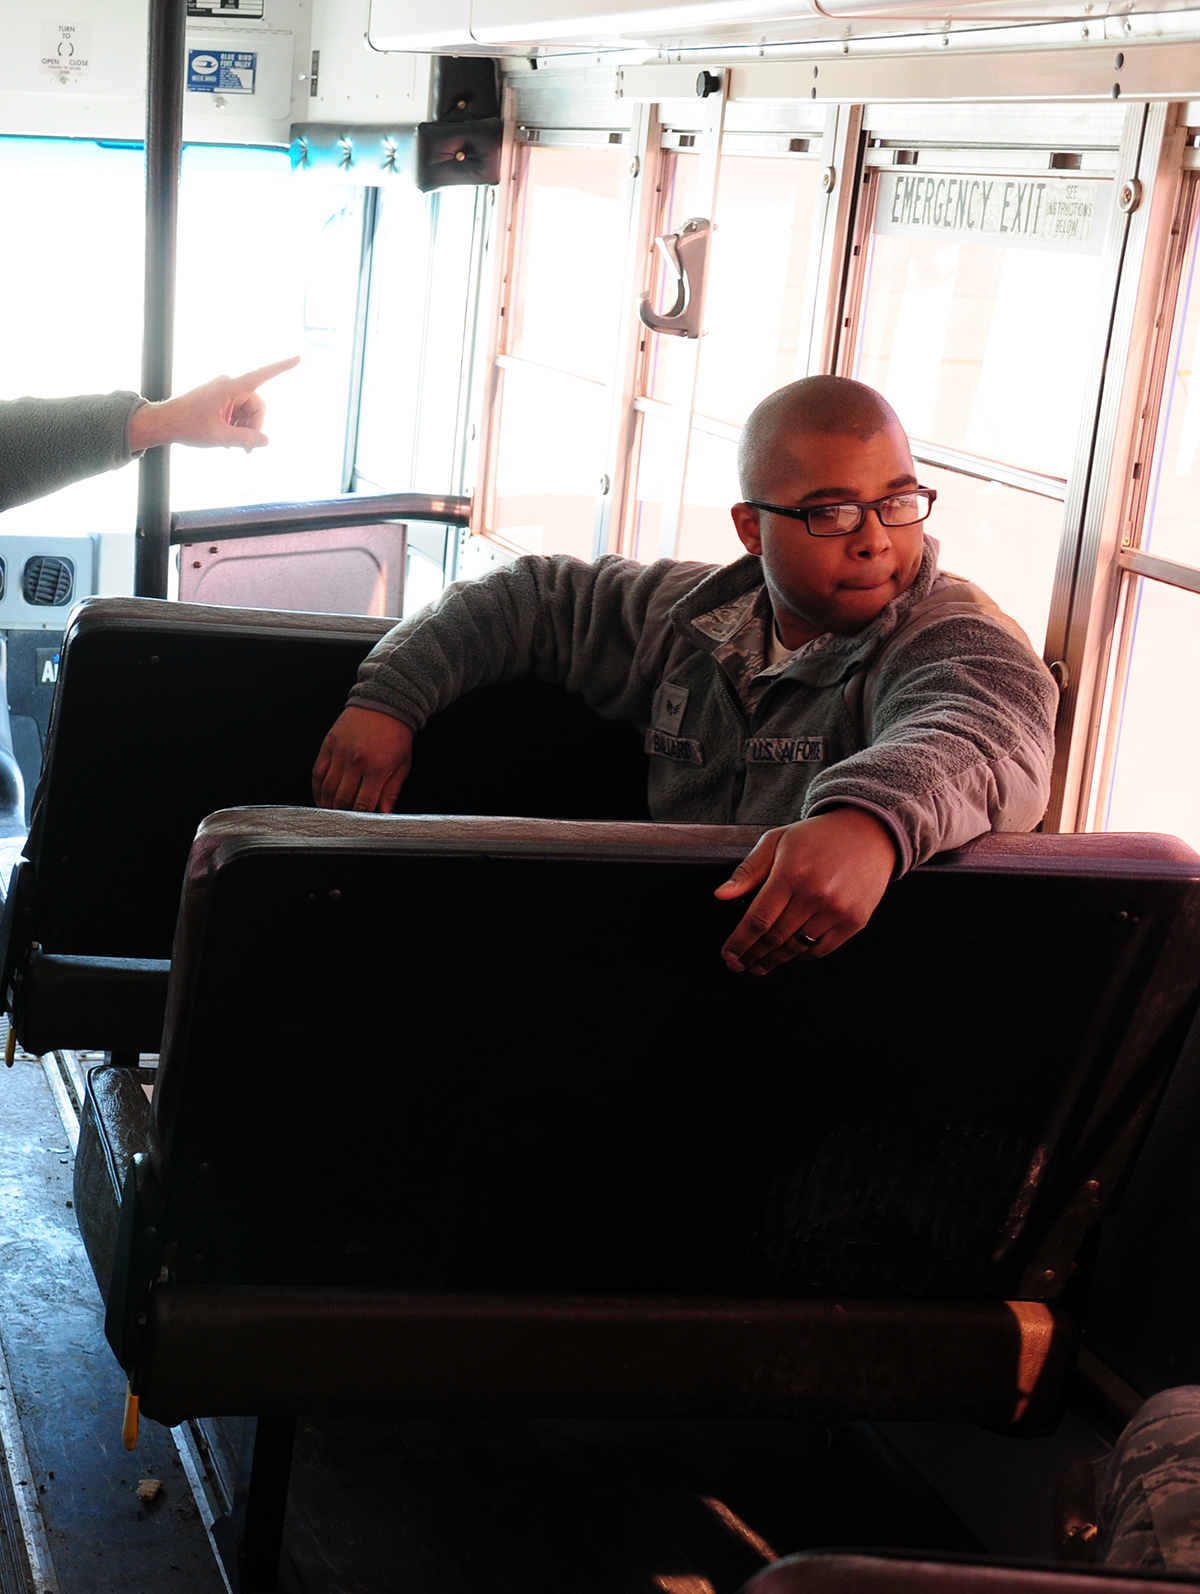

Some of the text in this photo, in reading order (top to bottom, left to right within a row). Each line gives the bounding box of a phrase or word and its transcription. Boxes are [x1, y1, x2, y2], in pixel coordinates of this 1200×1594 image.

[220, 53, 235, 61] BLUE
[1065, 184, 1079, 200] SEE
[891, 176, 1046, 234] EMERGENCY EXIT
[1045, 201, 1093, 217] INSTRUCTIONS
[1054, 219, 1079, 234] BELOW
